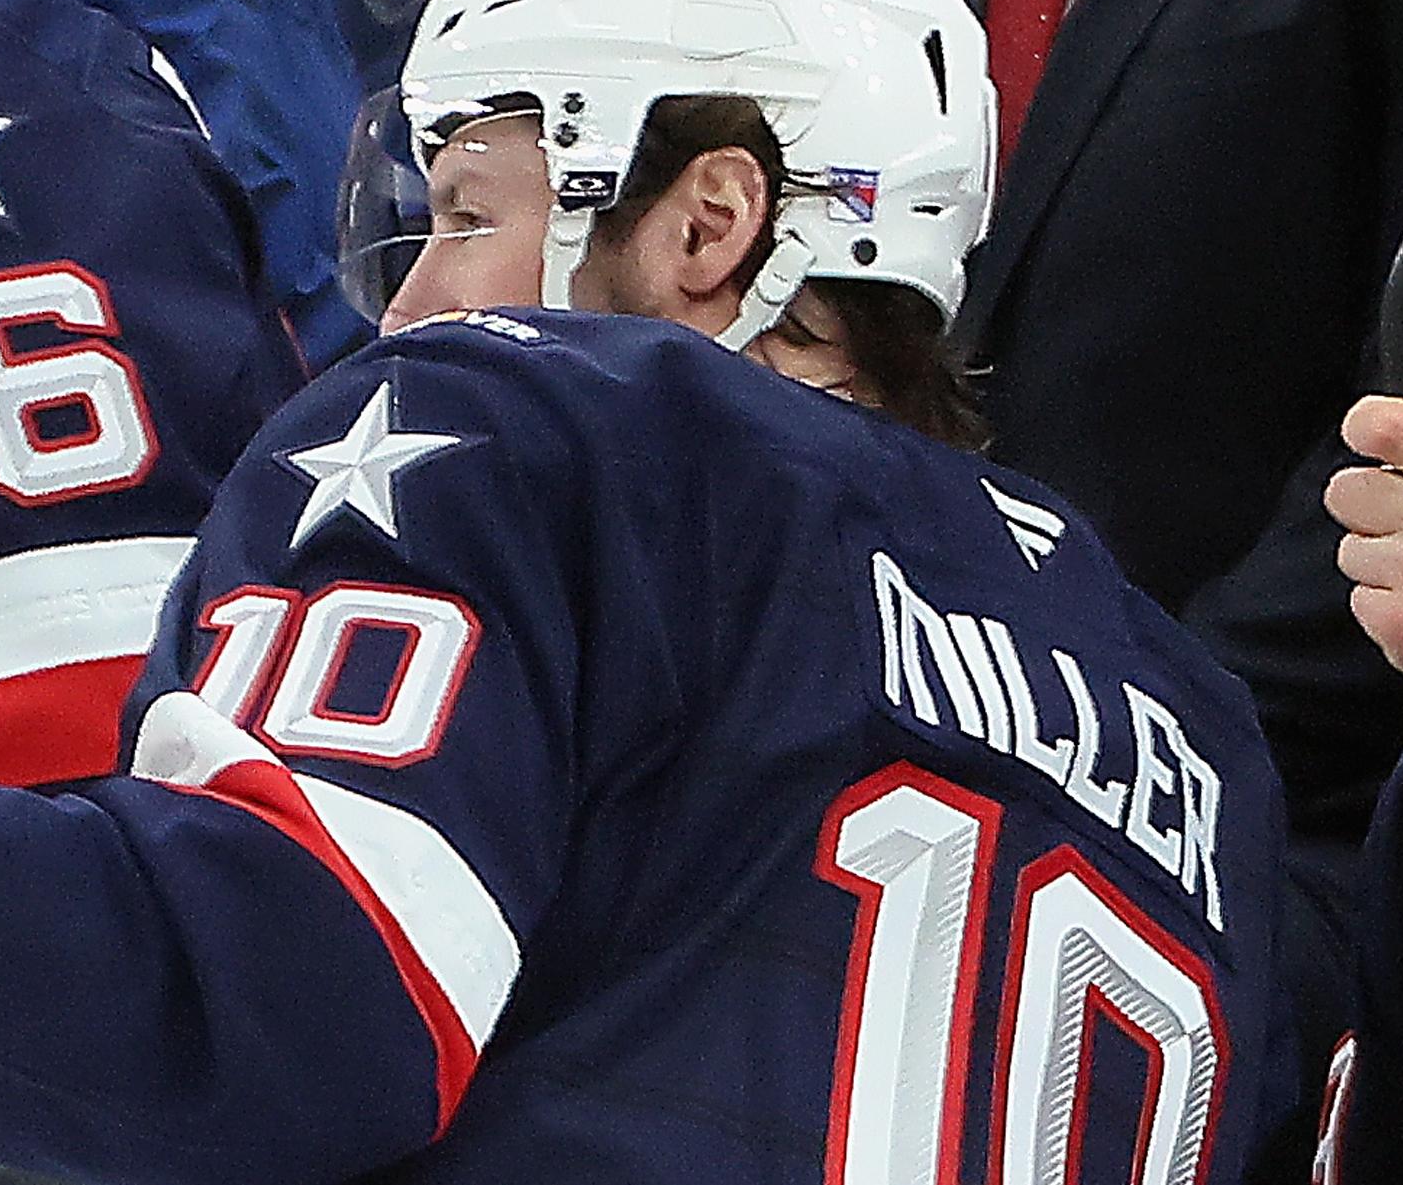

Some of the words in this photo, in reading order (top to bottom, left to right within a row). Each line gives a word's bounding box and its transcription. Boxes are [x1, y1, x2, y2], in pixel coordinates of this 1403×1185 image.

[192, 579, 484, 770] 10
[873, 551, 1225, 934] MILLER
[814, 759, 1231, 1185] 10
